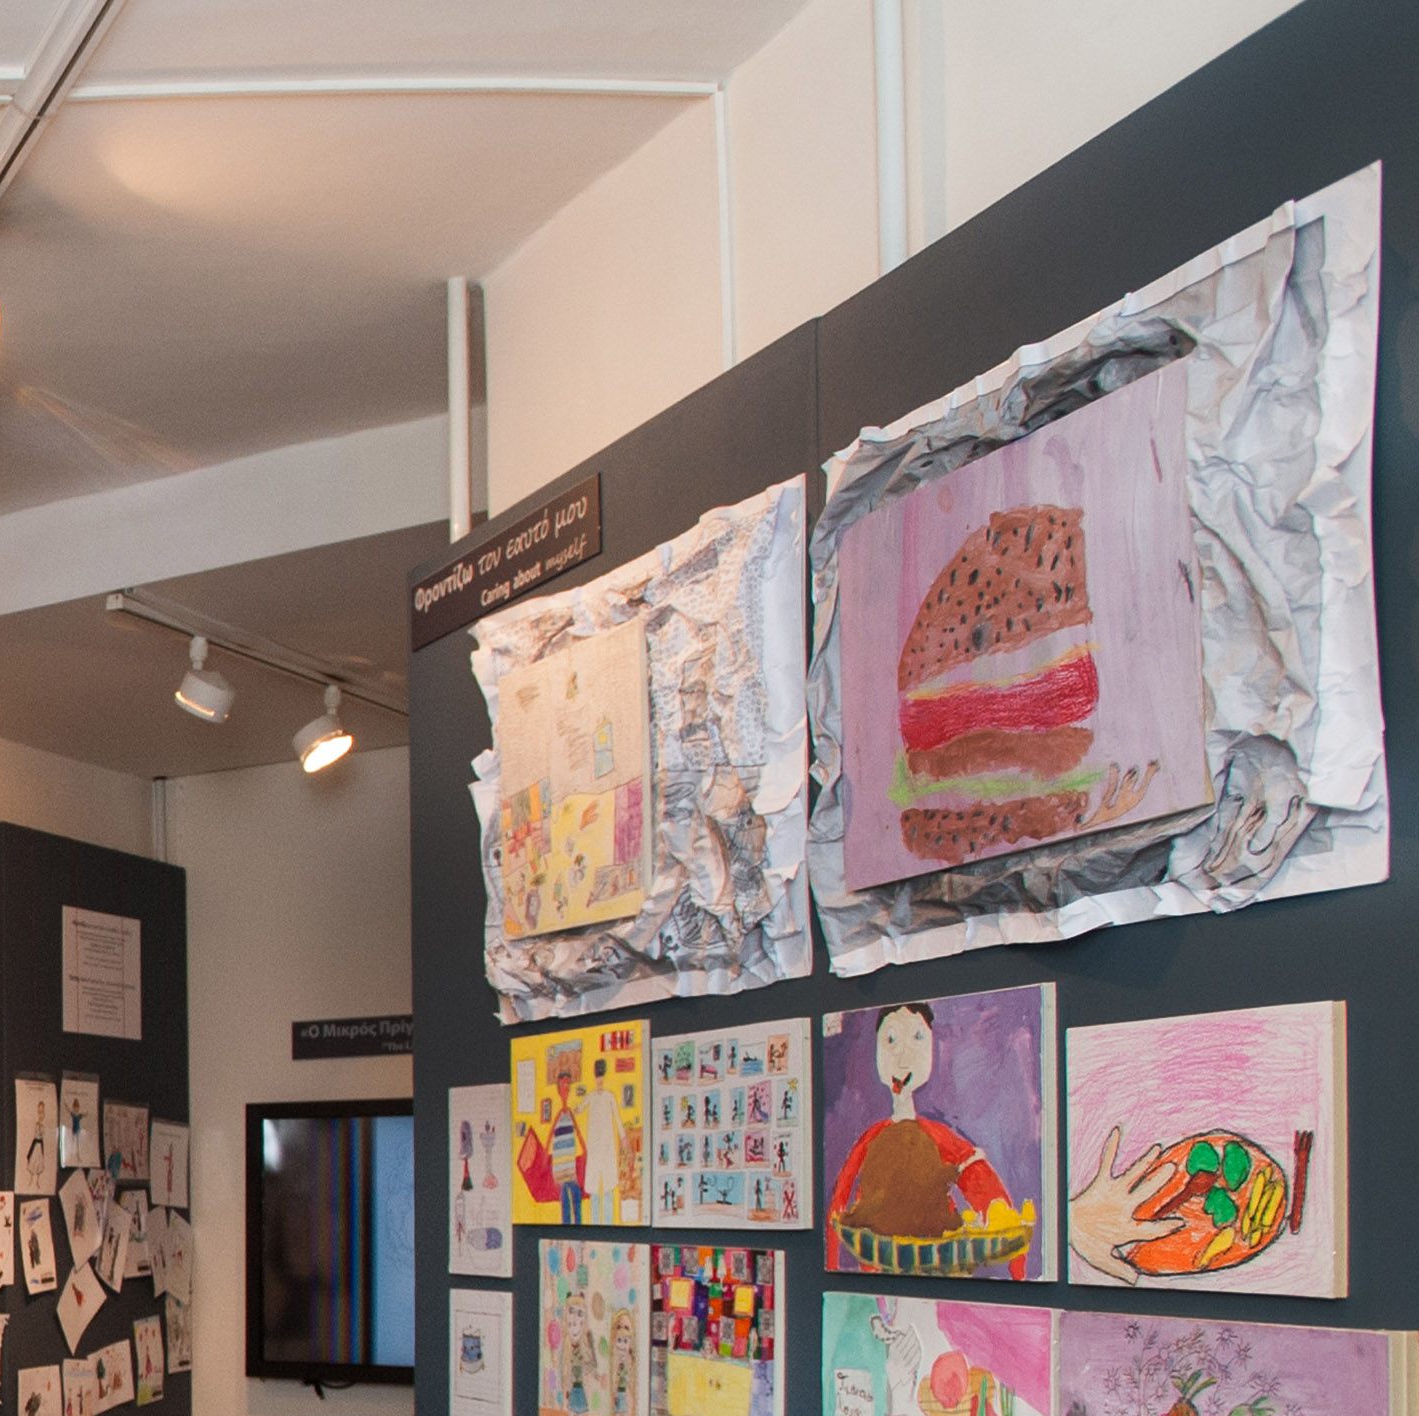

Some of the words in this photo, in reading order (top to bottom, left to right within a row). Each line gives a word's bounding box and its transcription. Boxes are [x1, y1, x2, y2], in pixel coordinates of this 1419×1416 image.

[413, 562, 475, 614] Φροντίζω
[477, 546, 502, 577] τον
[505, 508, 551, 560] εαυτό
[554, 495, 589, 539] μου
[480, 579, 511, 607] Caring
[512, 560, 542, 591] about
[545, 532, 589, 573] myself
[323, 1022, 377, 1040] Μικρός
[379, 1019, 413, 1037] Πρίγ
